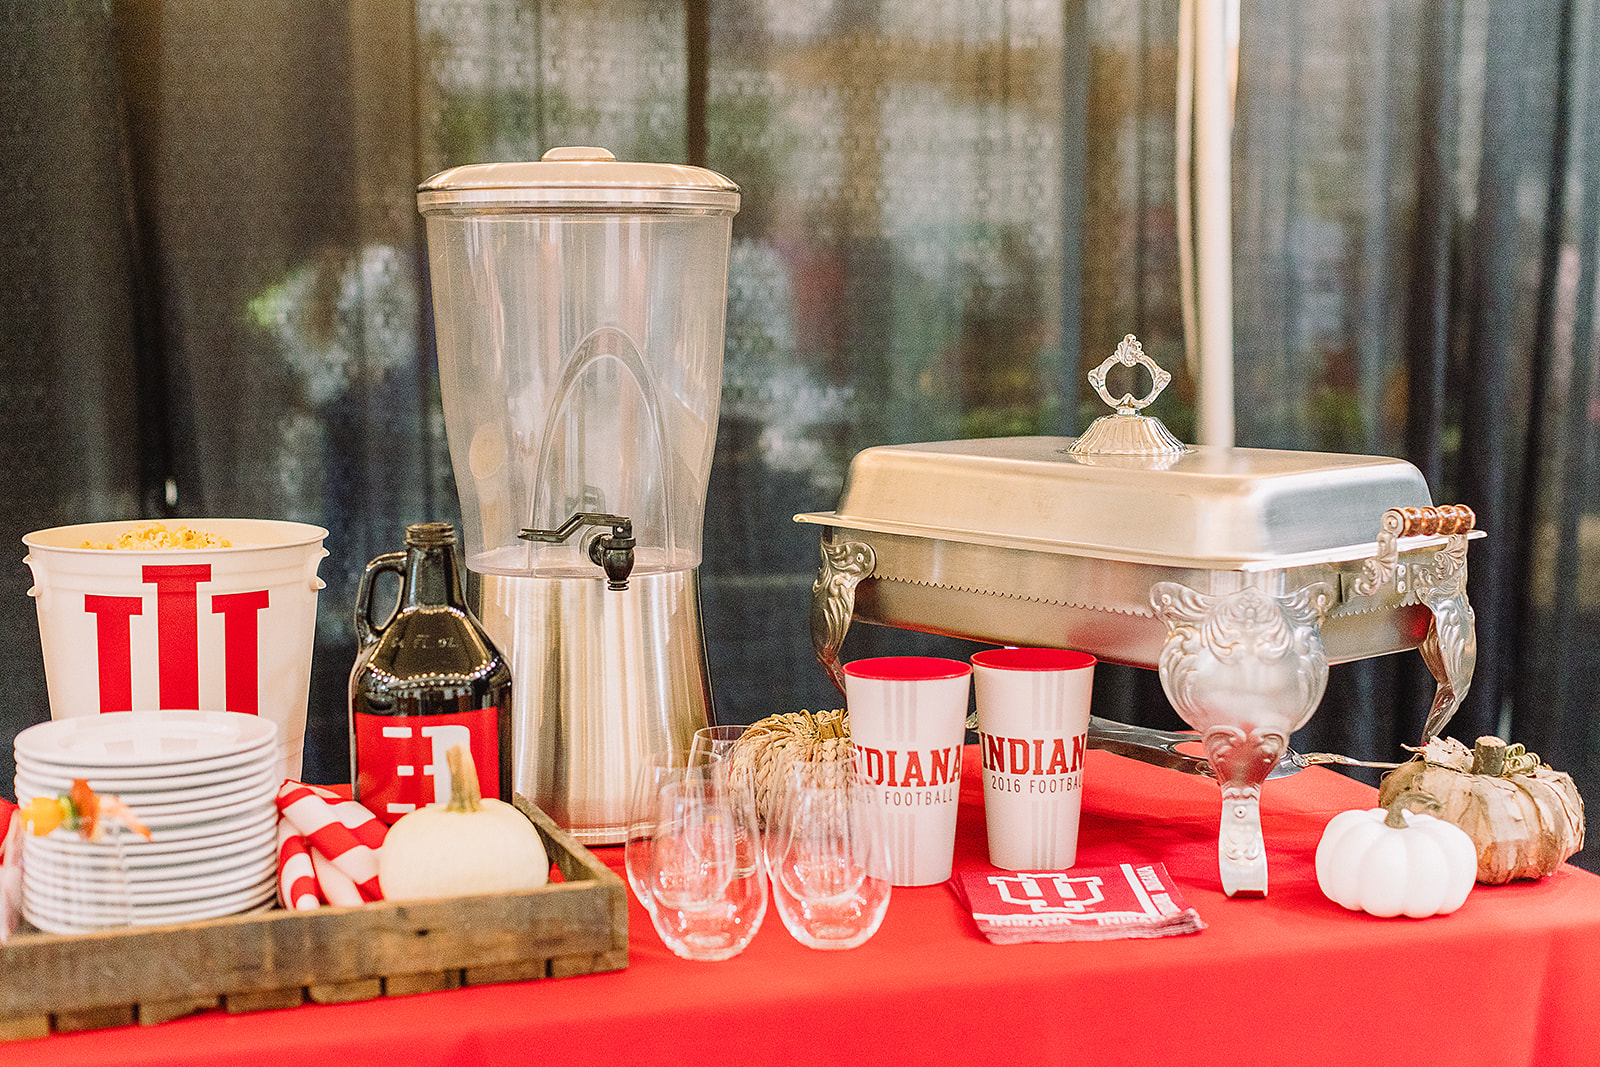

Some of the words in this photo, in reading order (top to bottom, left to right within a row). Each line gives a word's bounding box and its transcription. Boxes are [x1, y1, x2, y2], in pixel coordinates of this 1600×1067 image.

[980, 731, 1086, 776] INDIAN
[991, 775, 1021, 793] 2016
[1029, 773, 1083, 794] FOOTBAL
[884, 788, 953, 807] FOOTBALL
